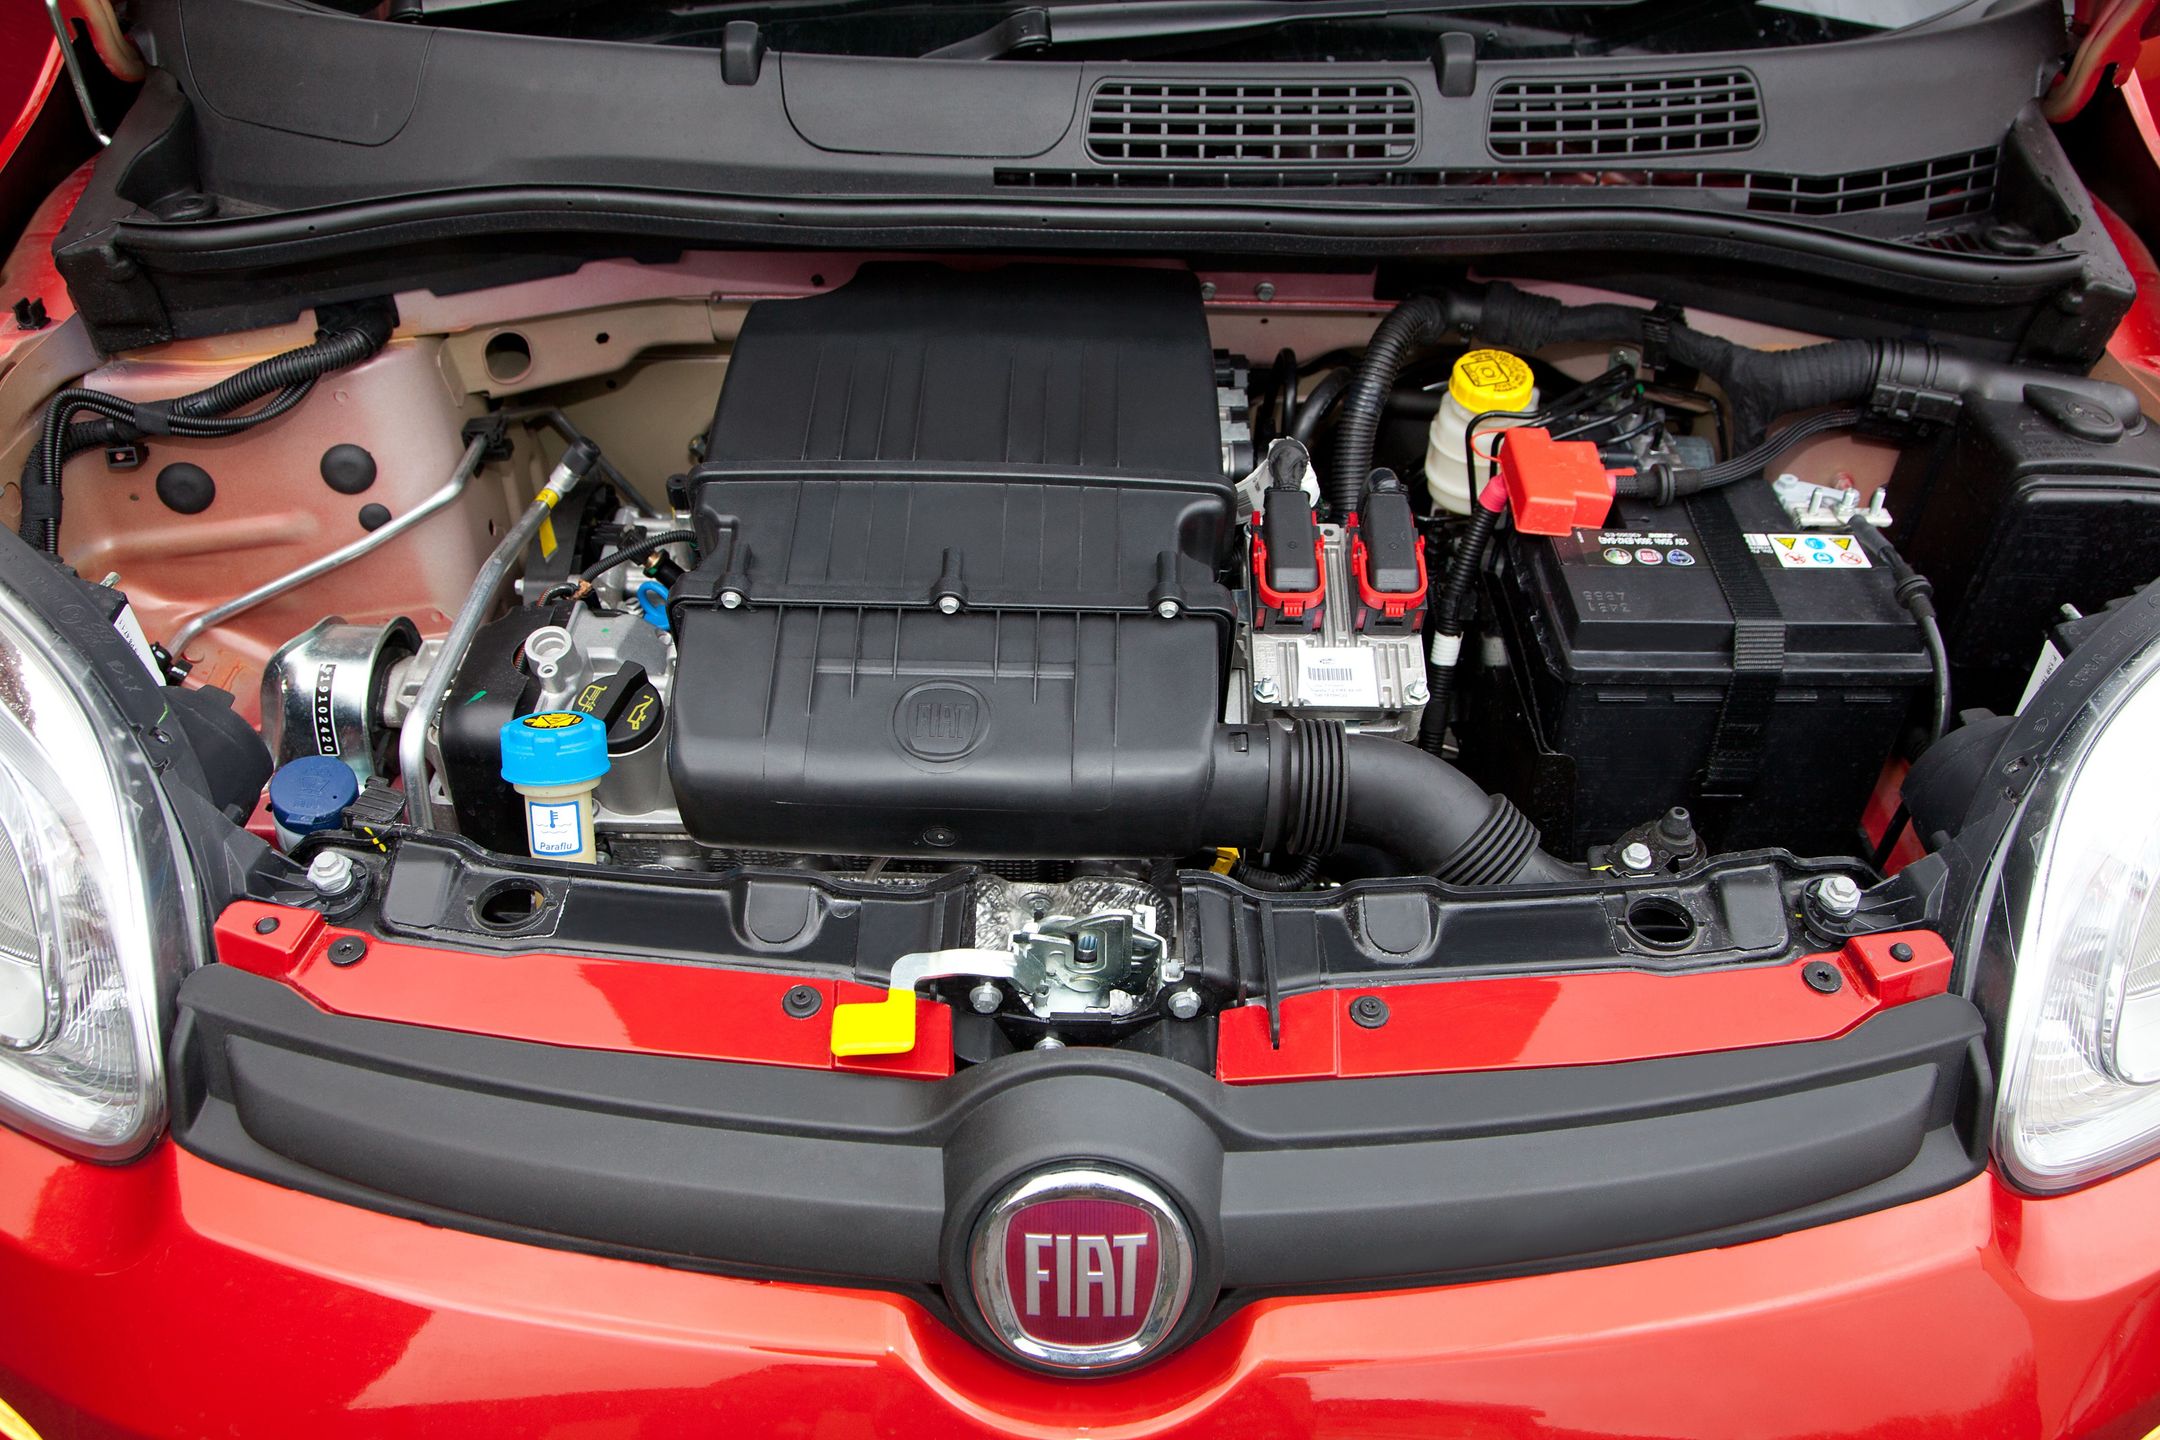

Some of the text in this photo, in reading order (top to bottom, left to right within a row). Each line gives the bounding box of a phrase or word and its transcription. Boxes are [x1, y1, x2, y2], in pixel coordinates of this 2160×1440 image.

[916, 703, 971, 738] FIAT
[540, 842, 572, 851] Paraflu
[1024, 1234, 1148, 1317] FIAT
